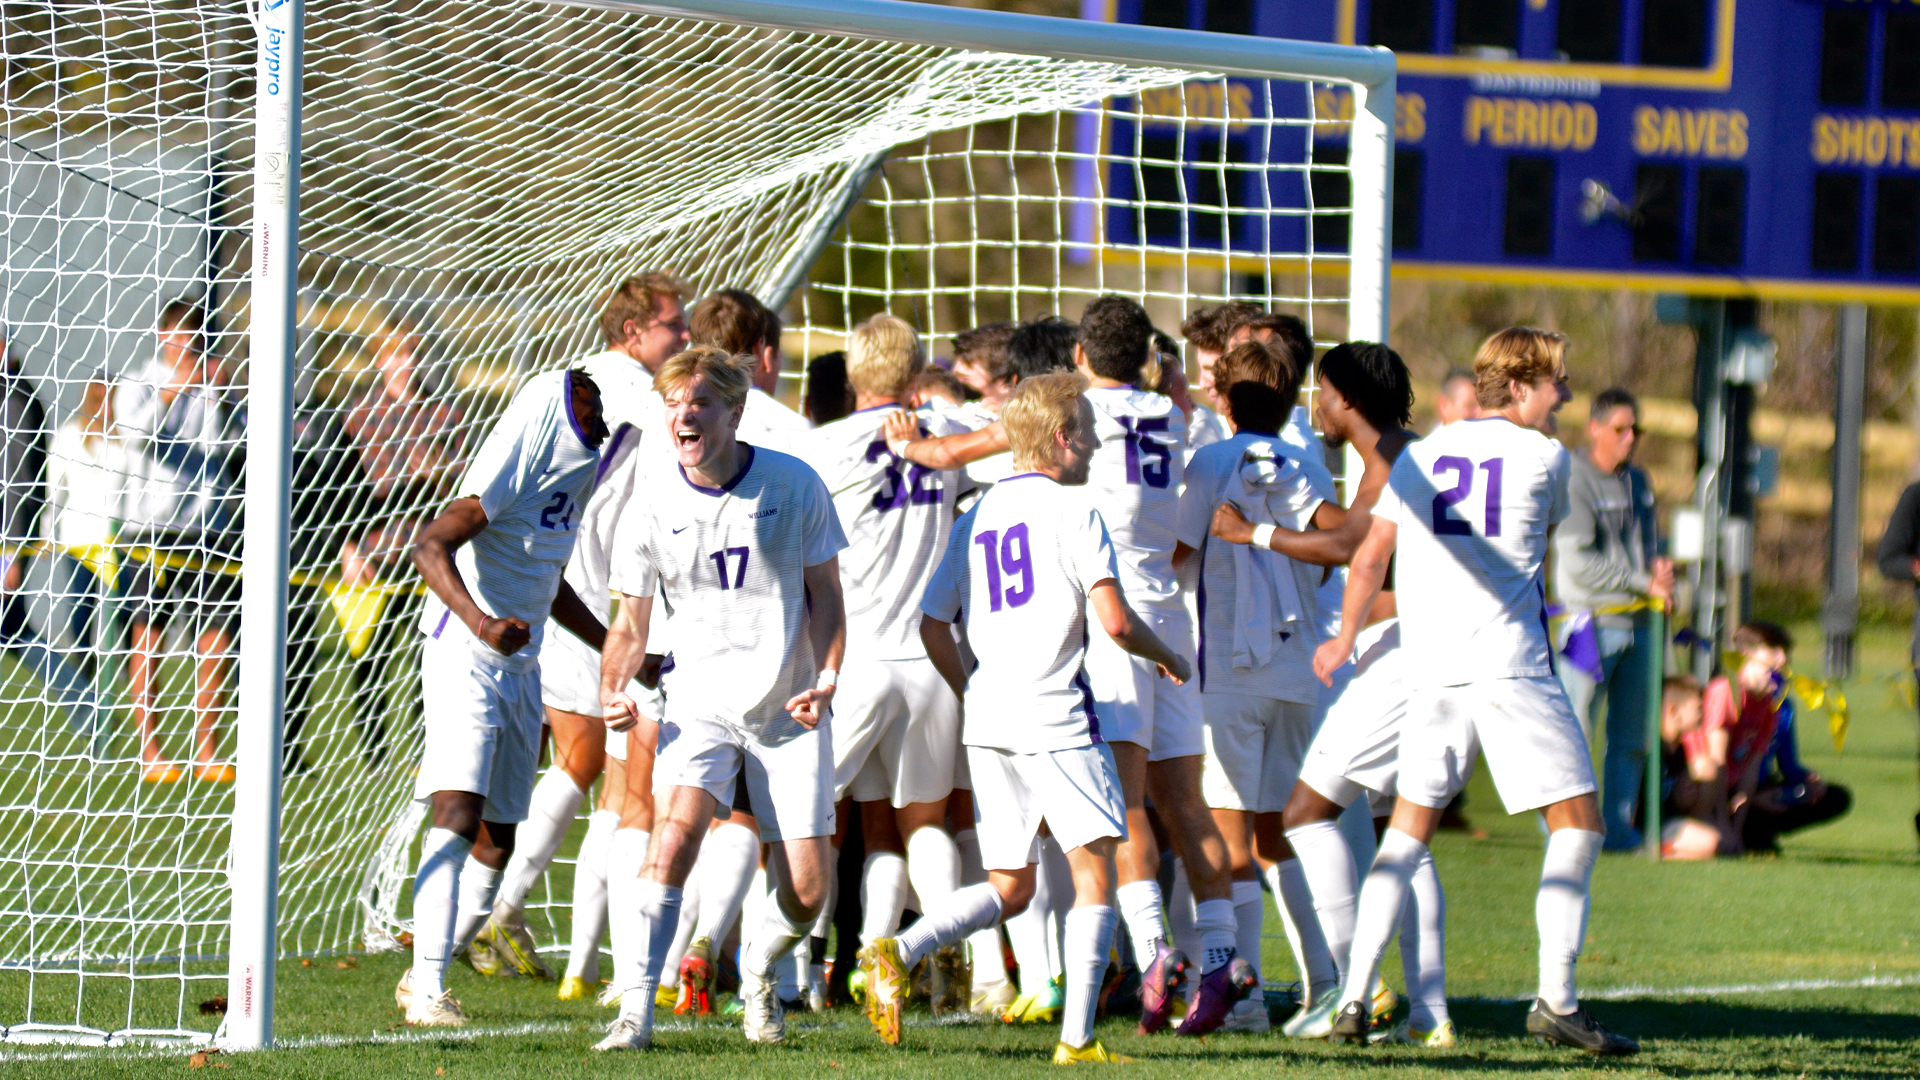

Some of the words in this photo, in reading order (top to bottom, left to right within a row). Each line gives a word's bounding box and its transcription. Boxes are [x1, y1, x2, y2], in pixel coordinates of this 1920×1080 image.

[264, 24, 285, 96] jaypro
[1313, 89, 1427, 142] SAS
[1465, 98, 1597, 149] PERIOD
[1634, 106, 1749, 158] SAVES
[262, 230, 270, 277] WARNING
[1115, 414, 1172, 489] 15
[748, 507, 778, 520] WILLIAMS
[1432, 455, 1504, 537] 21
[709, 546, 749, 590] 17
[974, 522, 1035, 613] 19
[245, 977, 253, 1018] WARNING
